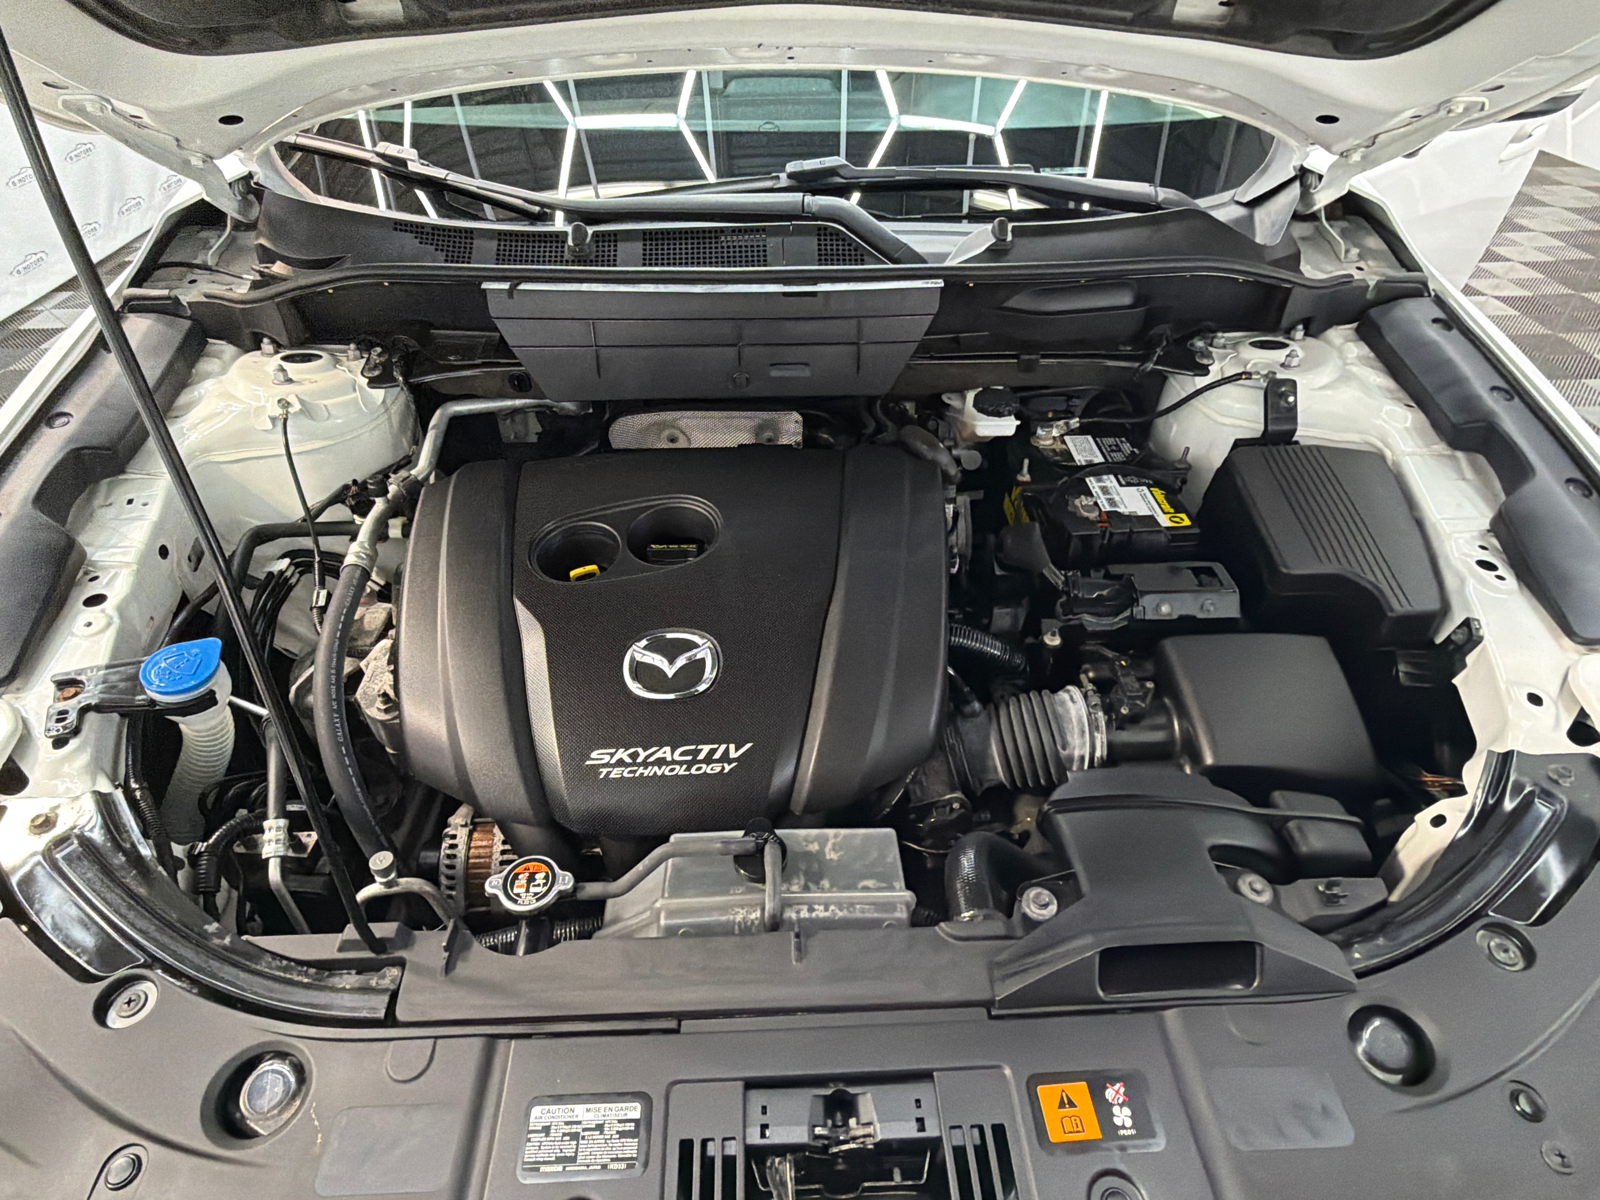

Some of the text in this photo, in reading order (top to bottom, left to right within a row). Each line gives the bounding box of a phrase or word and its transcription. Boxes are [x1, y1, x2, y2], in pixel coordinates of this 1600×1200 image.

[17, 173, 34, 185] MOTO
[22, 256, 46, 272] MOTORS
[333, 712, 344, 742] GALAXY
[585, 742, 754, 765] SKYACTIV
[599, 762, 738, 778] TECHNOLOGY
[540, 1107, 575, 1115] CAUTION
